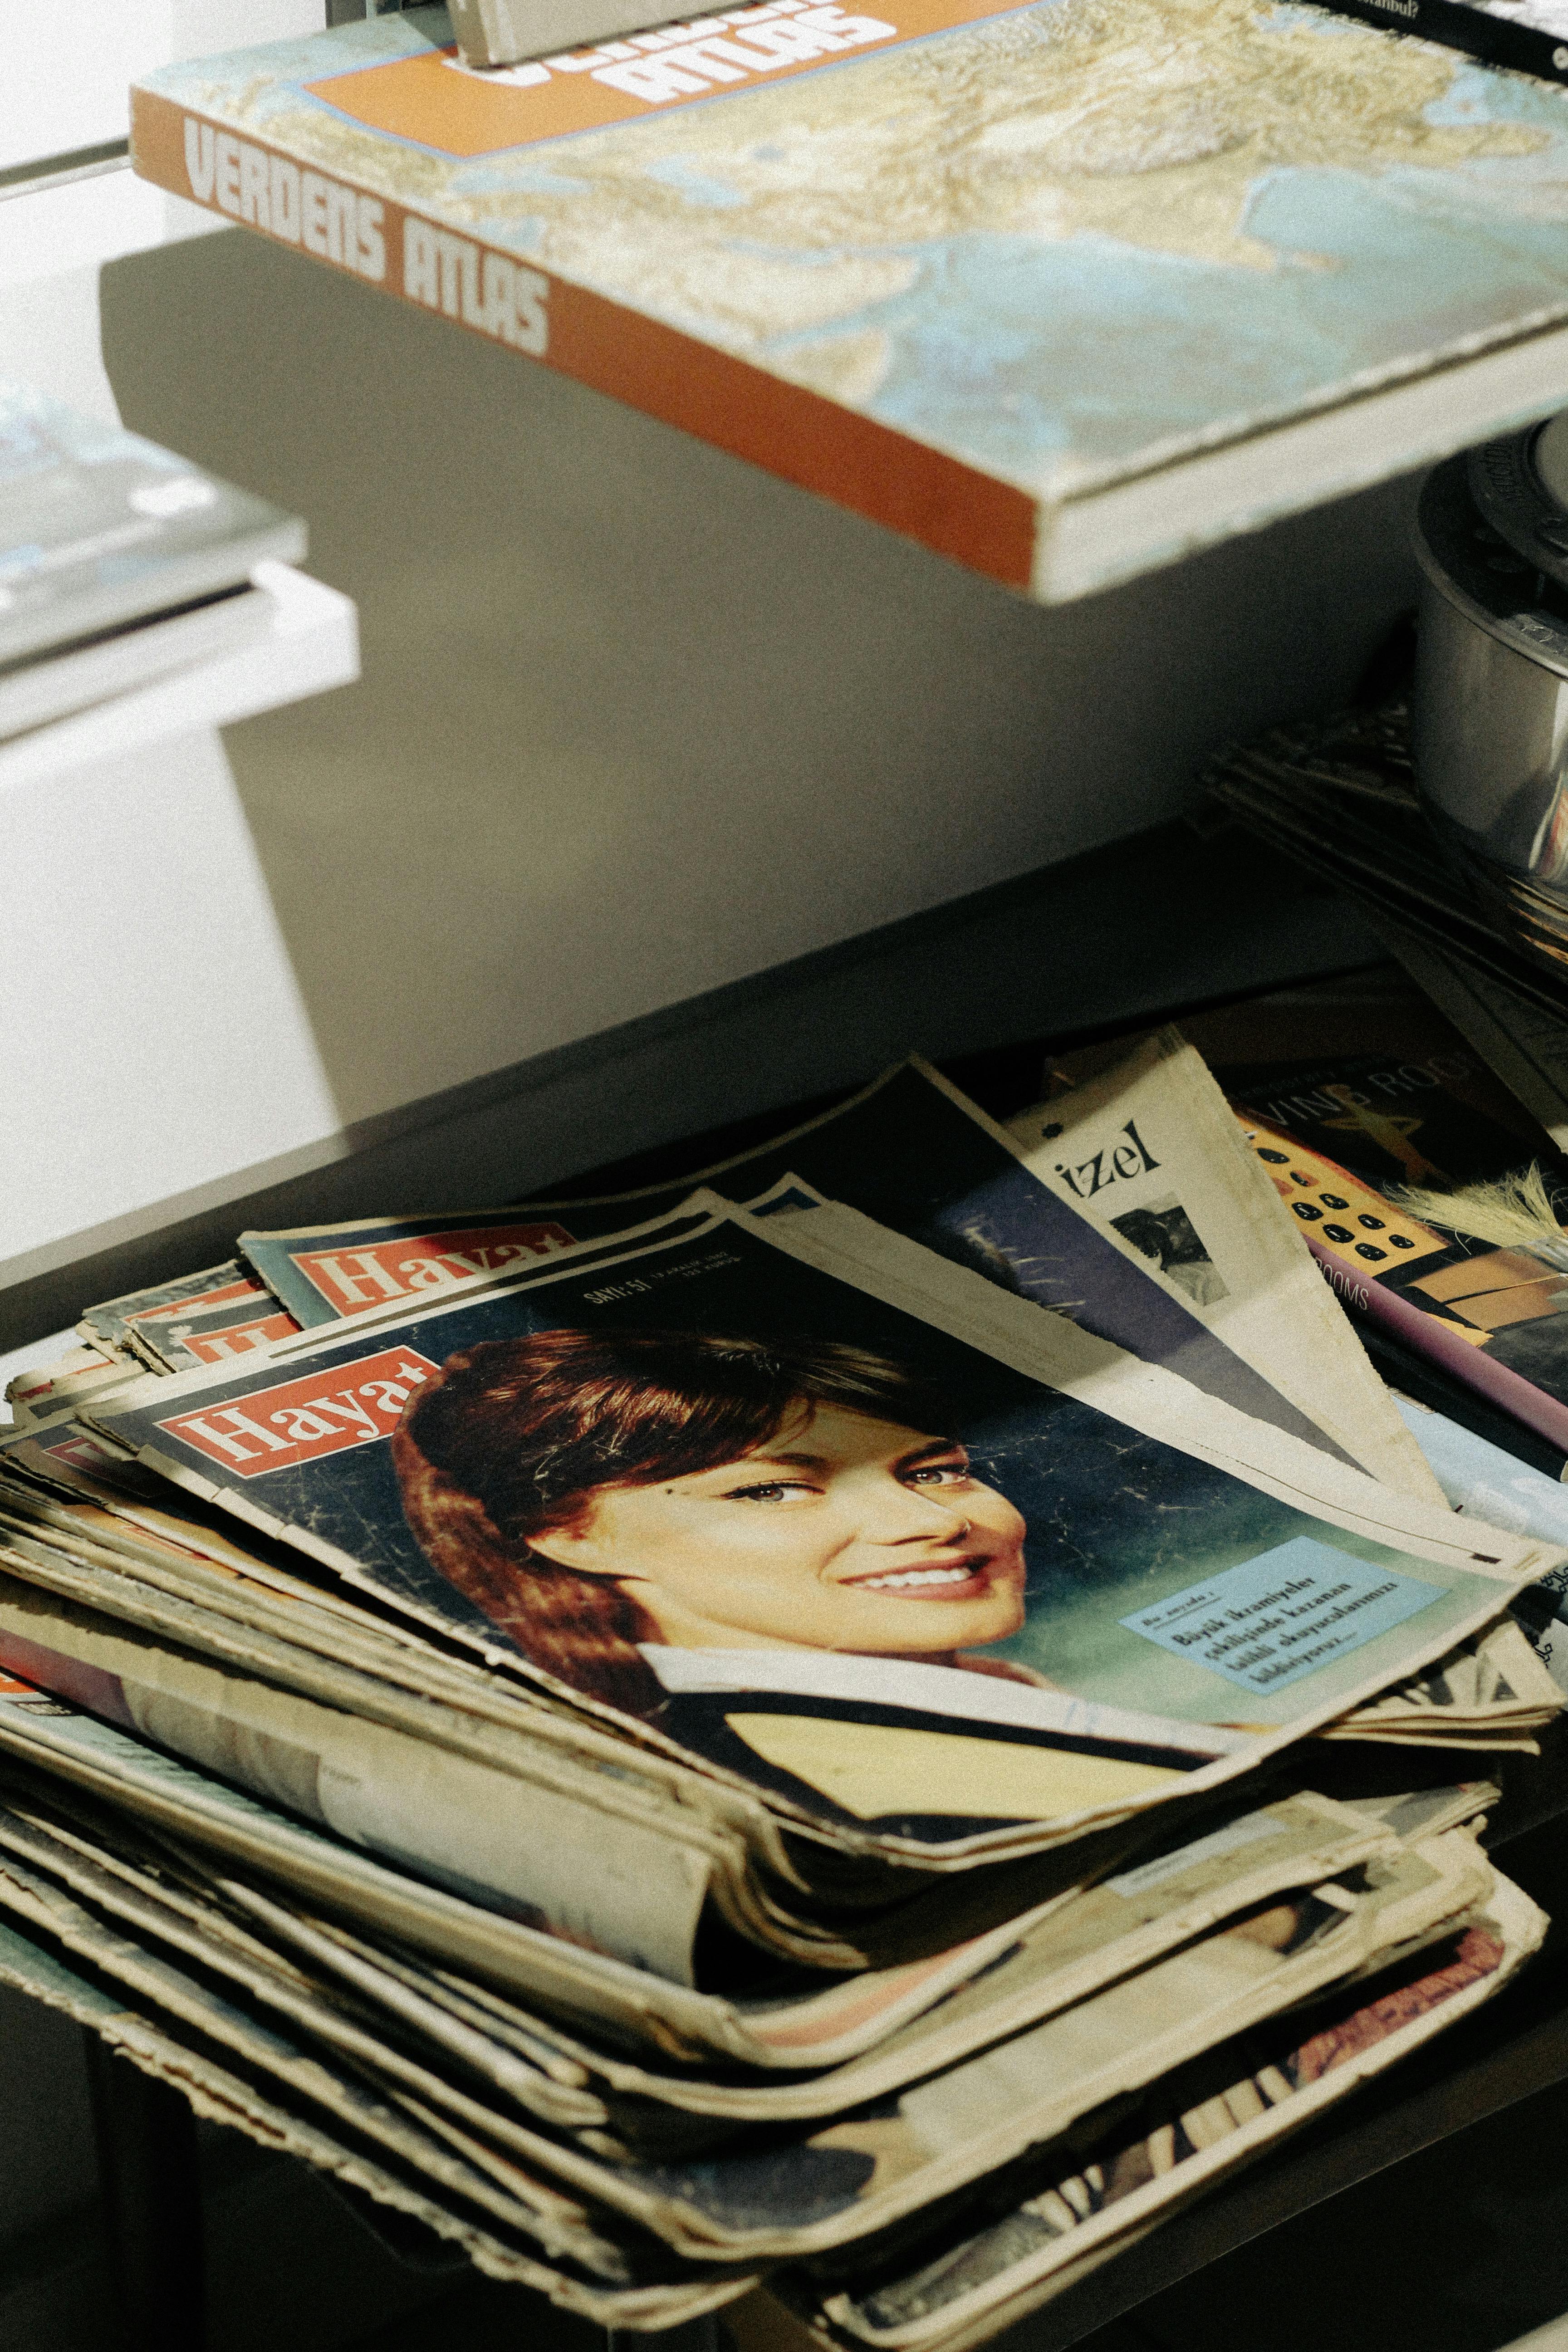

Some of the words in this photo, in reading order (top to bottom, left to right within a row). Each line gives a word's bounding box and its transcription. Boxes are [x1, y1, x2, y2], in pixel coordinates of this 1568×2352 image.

[590, 4, 897, 104] ATLAS
[184, 116, 386, 282] VERDENS
[403, 215, 549, 356] ATLAS
[1055, 1120, 1160, 1197] izel
[583, 1284, 633, 1305] SAYI:
[625, 1278, 652, 1292] 51
[177, 1362, 427, 1462] Hayat
[1172, 1618, 1226, 1646] Büyük
[1280, 1582, 1352, 1618] kazanan
